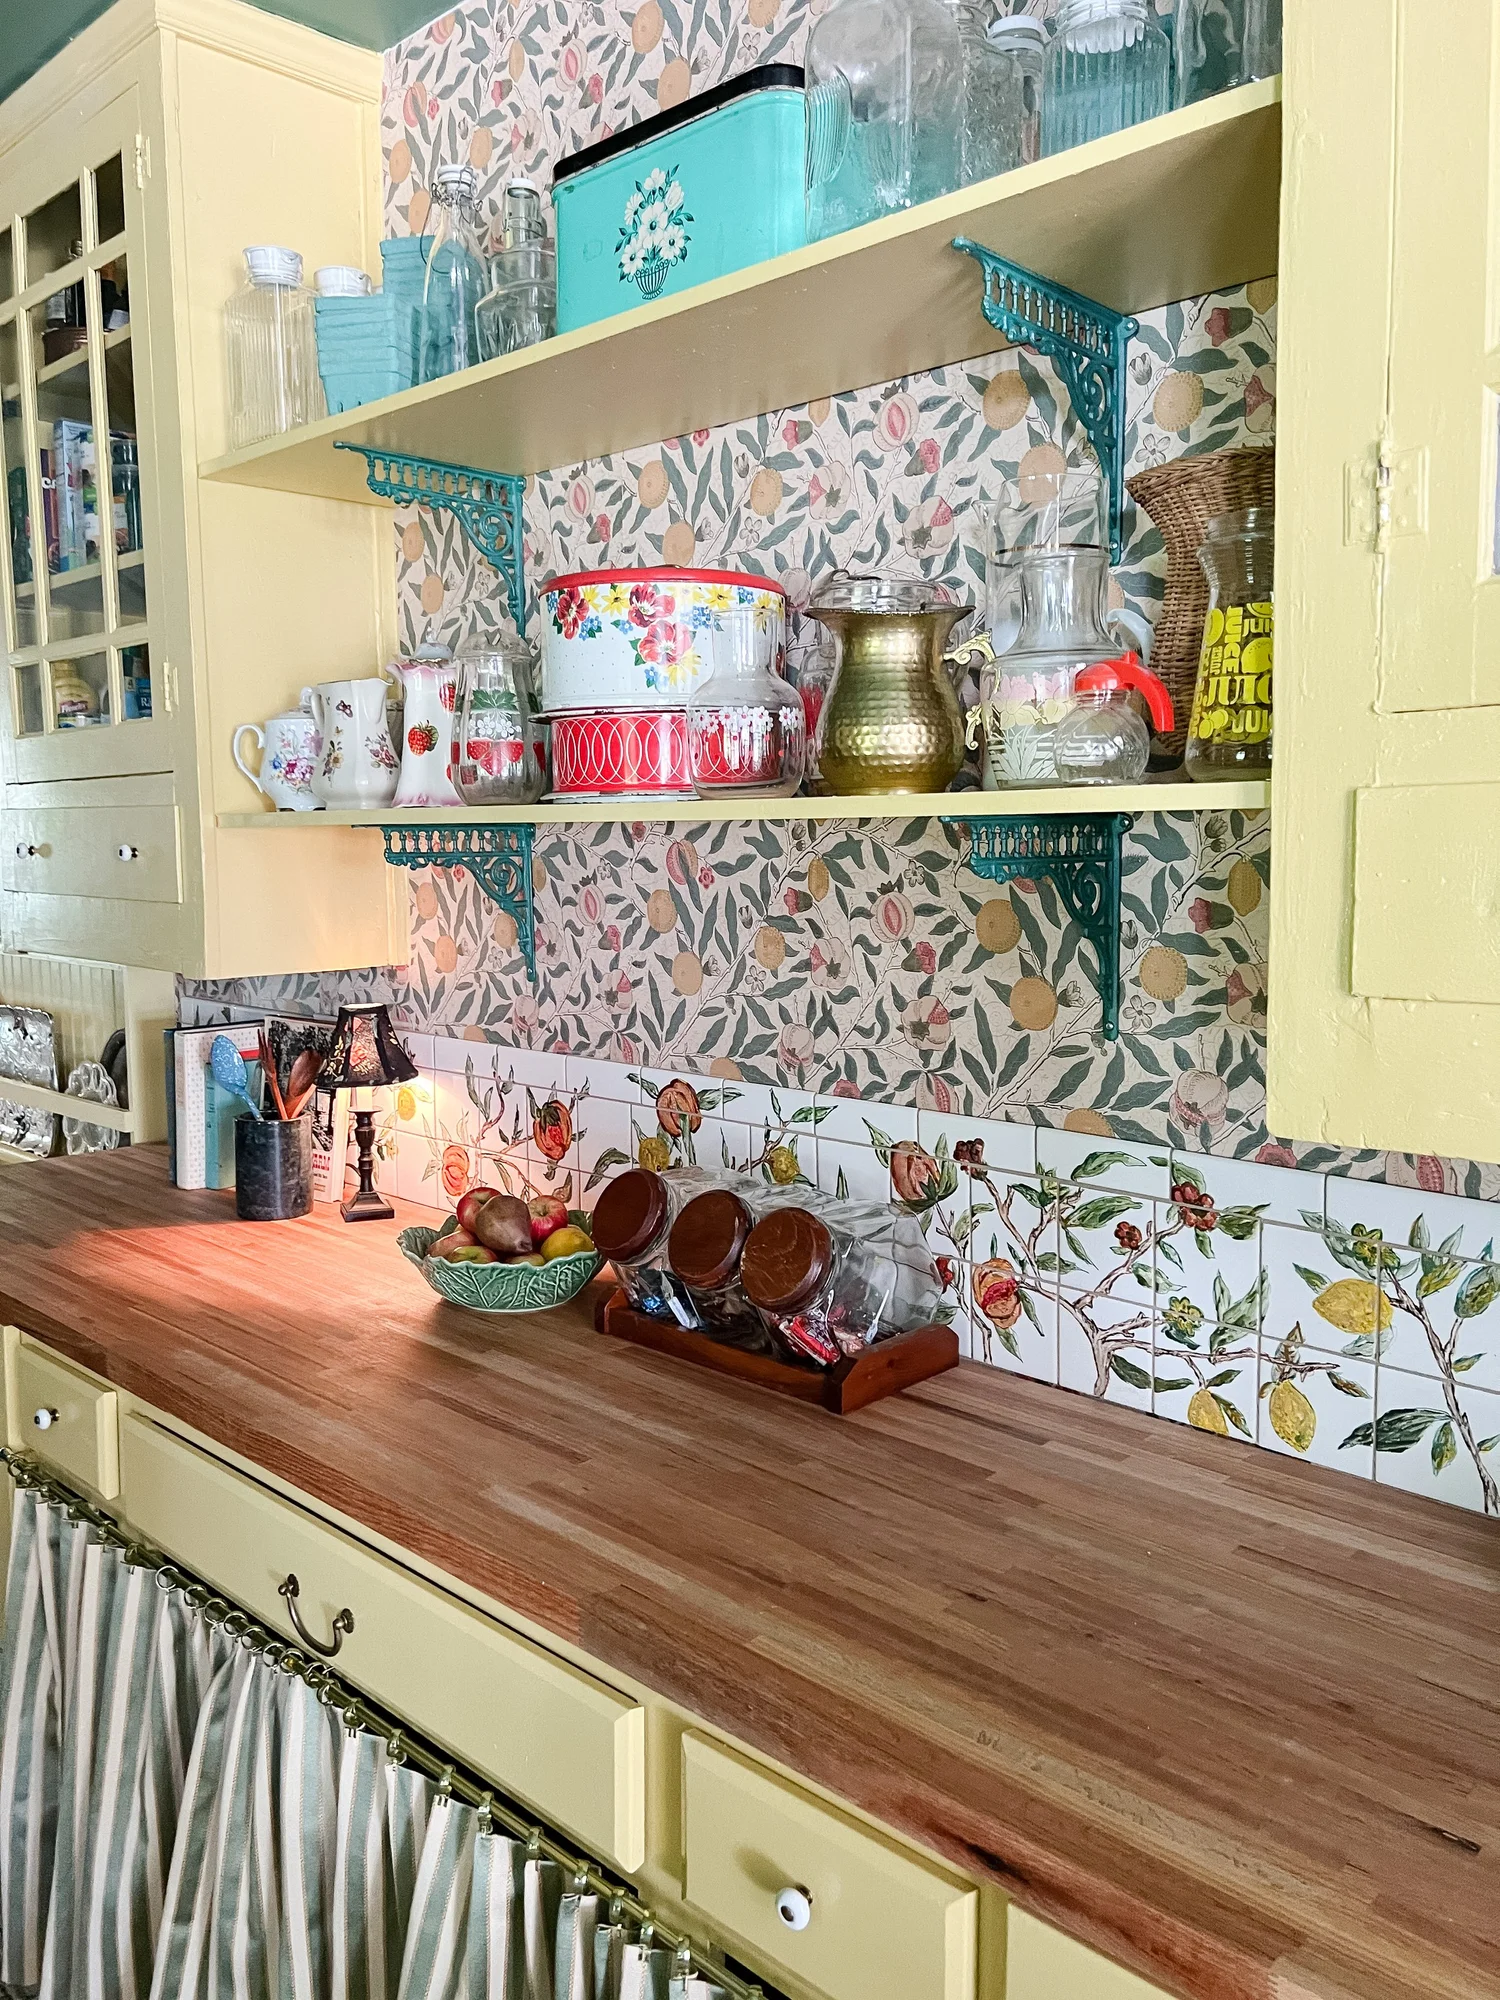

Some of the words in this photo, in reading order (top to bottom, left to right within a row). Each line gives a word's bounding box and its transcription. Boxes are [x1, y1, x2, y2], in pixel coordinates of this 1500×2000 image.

[1223, 605, 1243, 674] JUICE
[1242, 618, 1273, 637] JUI
[1231, 709, 1273, 734] JUI
